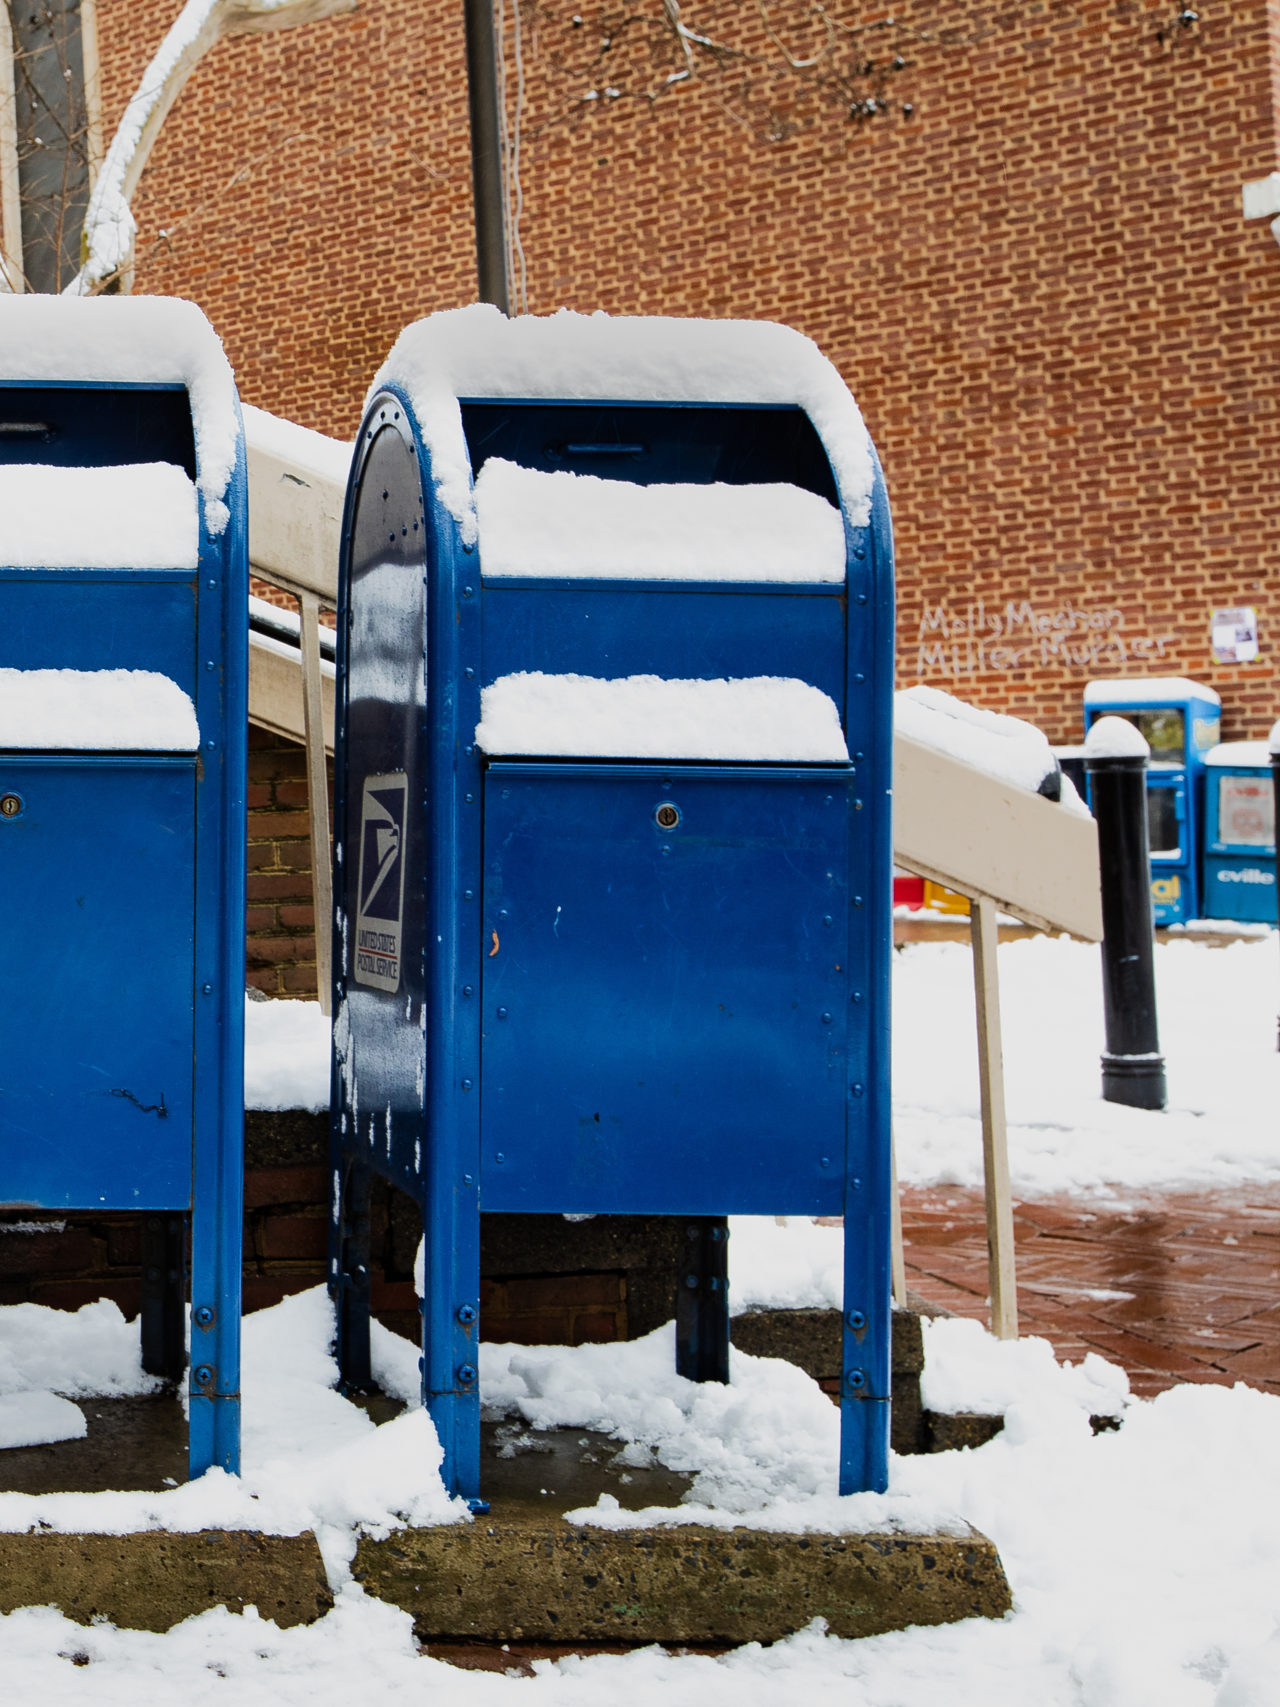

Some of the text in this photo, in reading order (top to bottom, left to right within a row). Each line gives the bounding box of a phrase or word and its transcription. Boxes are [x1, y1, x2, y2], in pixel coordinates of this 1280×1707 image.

[917, 641, 1027, 676] Miller
[1151, 874, 1181, 899] al
[358, 930, 396, 953] UNITED STATES
[357, 953, 398, 979] POSTAL SERVICE
